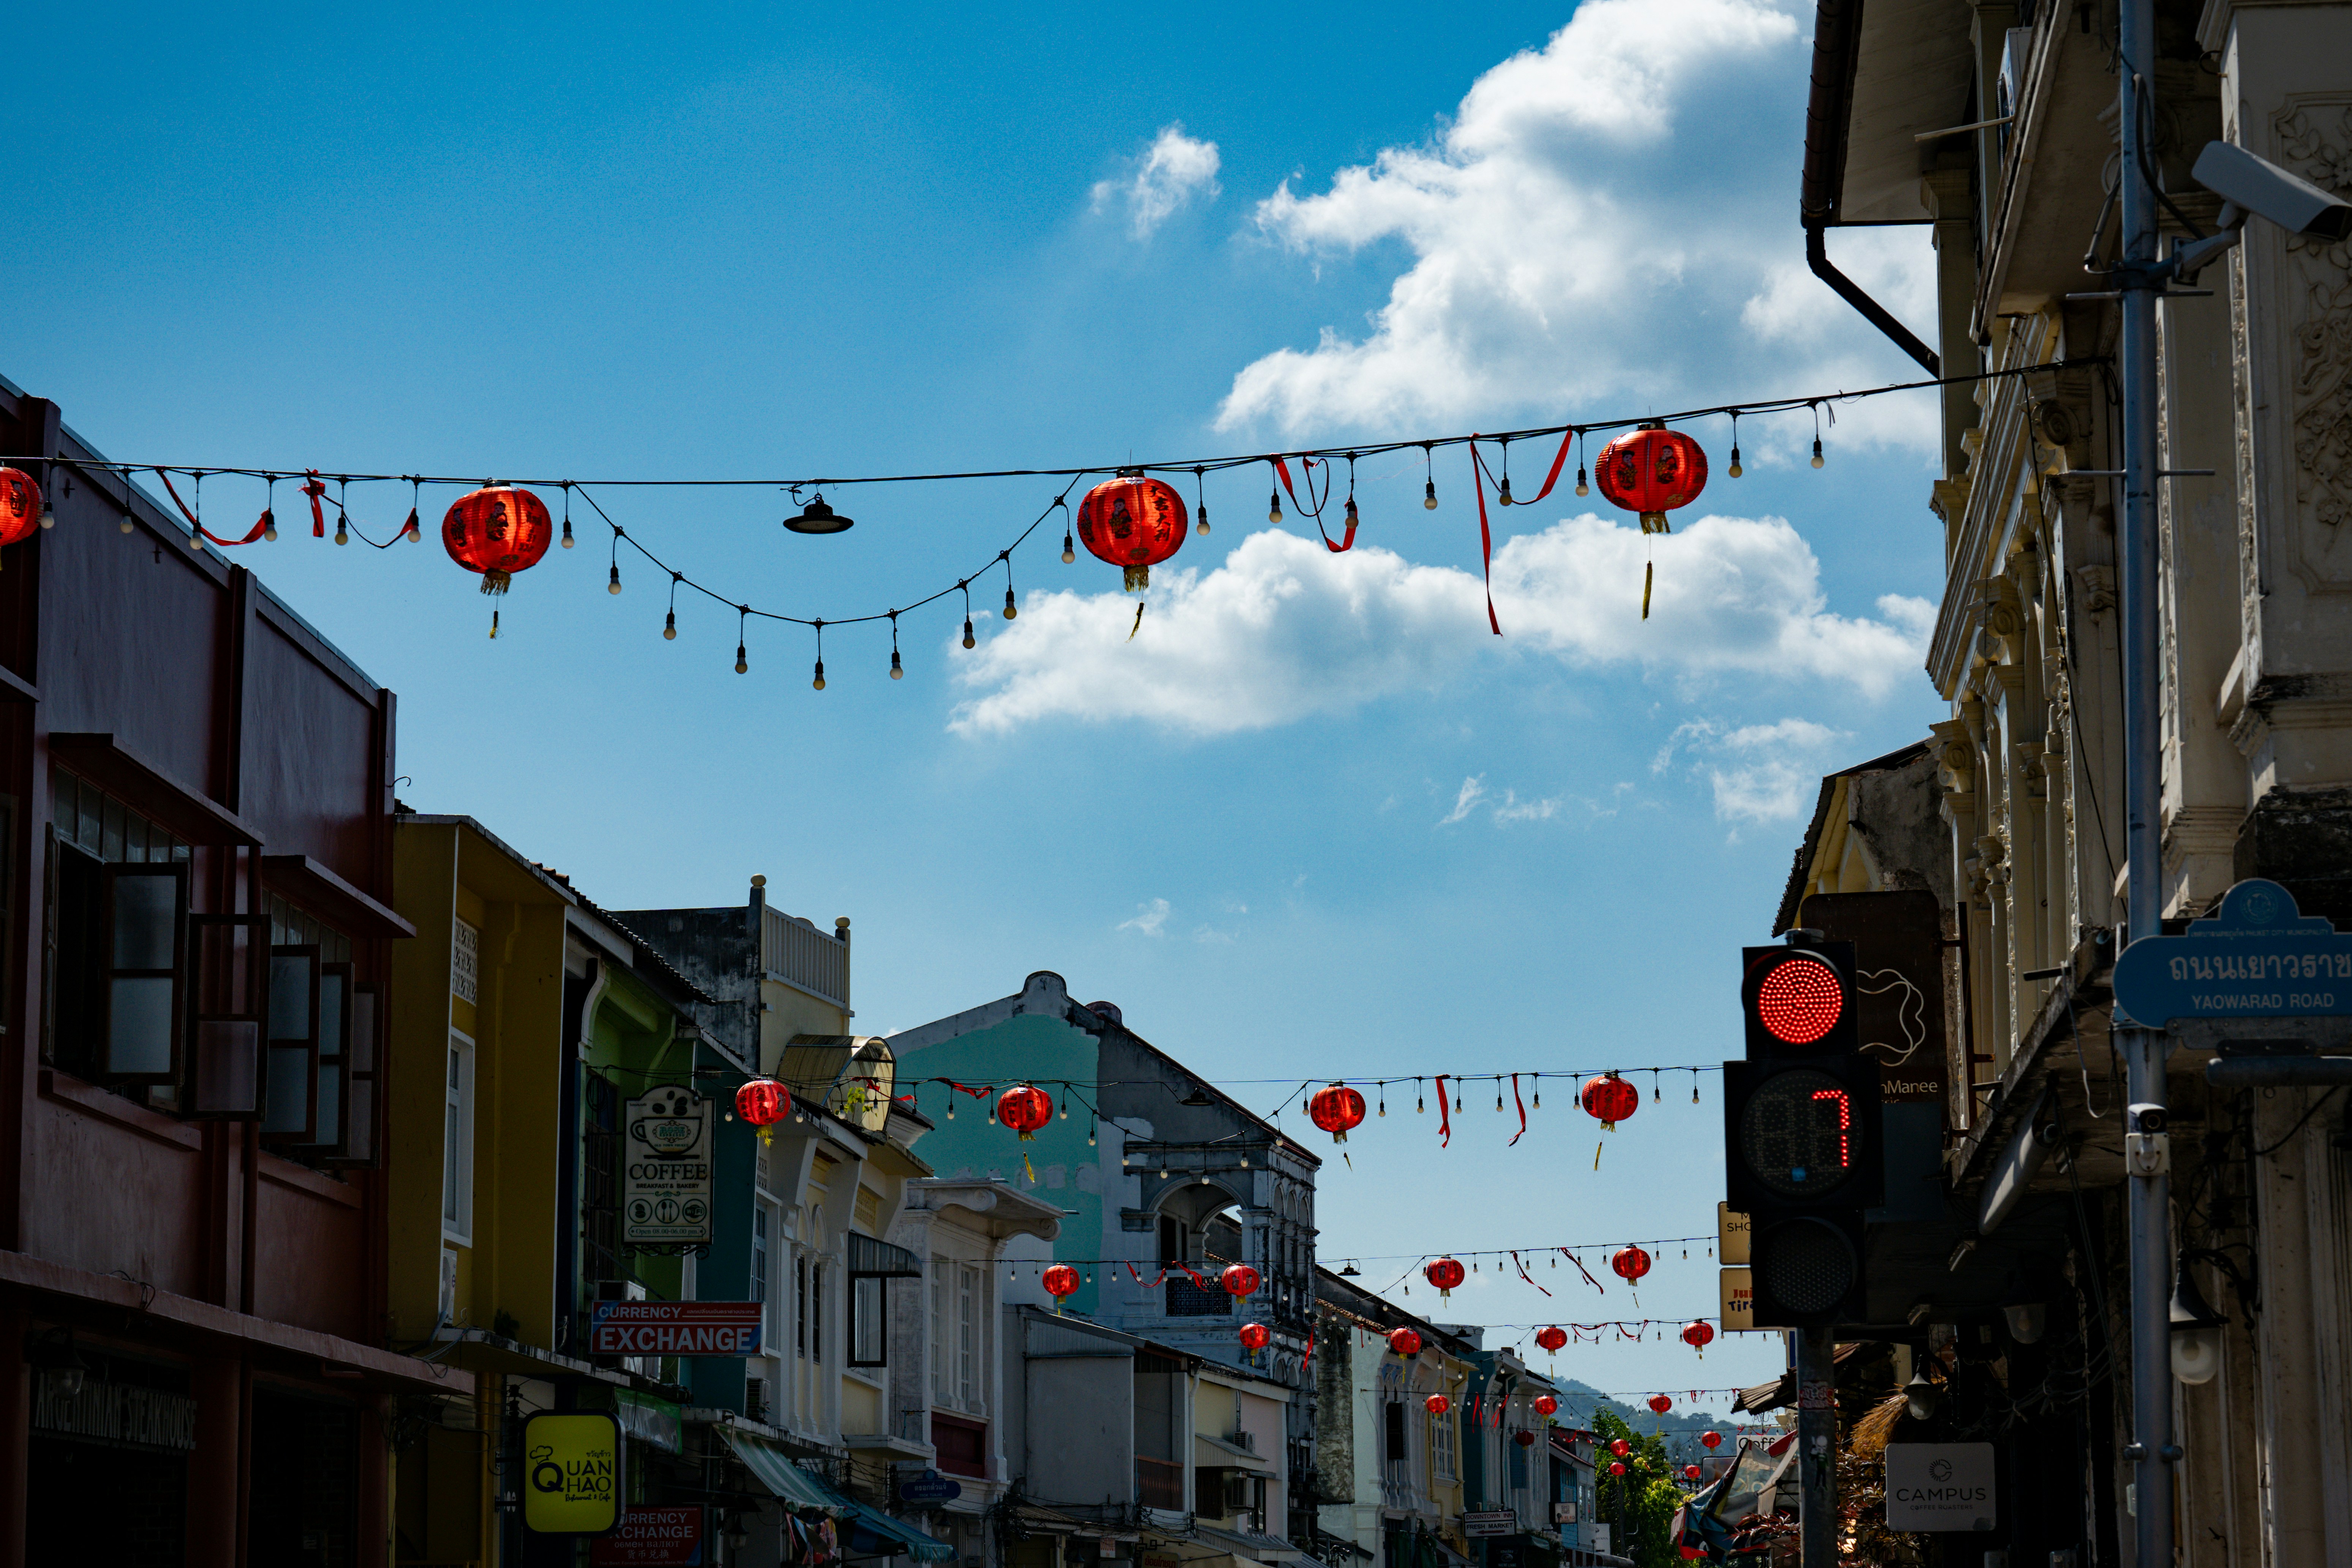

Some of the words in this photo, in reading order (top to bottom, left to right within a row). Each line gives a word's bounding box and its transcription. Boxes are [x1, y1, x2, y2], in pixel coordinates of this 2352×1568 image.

[1150, 485, 1171, 542] 大吉大利
[2169, 954, 2352, 980] ถนนเยาวราช
[2192, 994, 2283, 1010] YAOWARAD
[2289, 993, 2335, 1008] ROAD
[629, 1164, 707, 1180] COFFEE
[598, 1307, 681, 1318] CURRENCY
[599, 1327, 752, 1351] EXCHANGE
[126, 1386, 198, 1450] STEAKHOUSE
[586, 1450, 611, 1458] ขวัญข้าว
[1897, 1488, 1986, 1501] CAMPUS
[625, 1513, 688, 1524] RRENCY
[609, 1526, 694, 1539] CHANGE
[628, 1549, 669, 1559] 货币兑换
